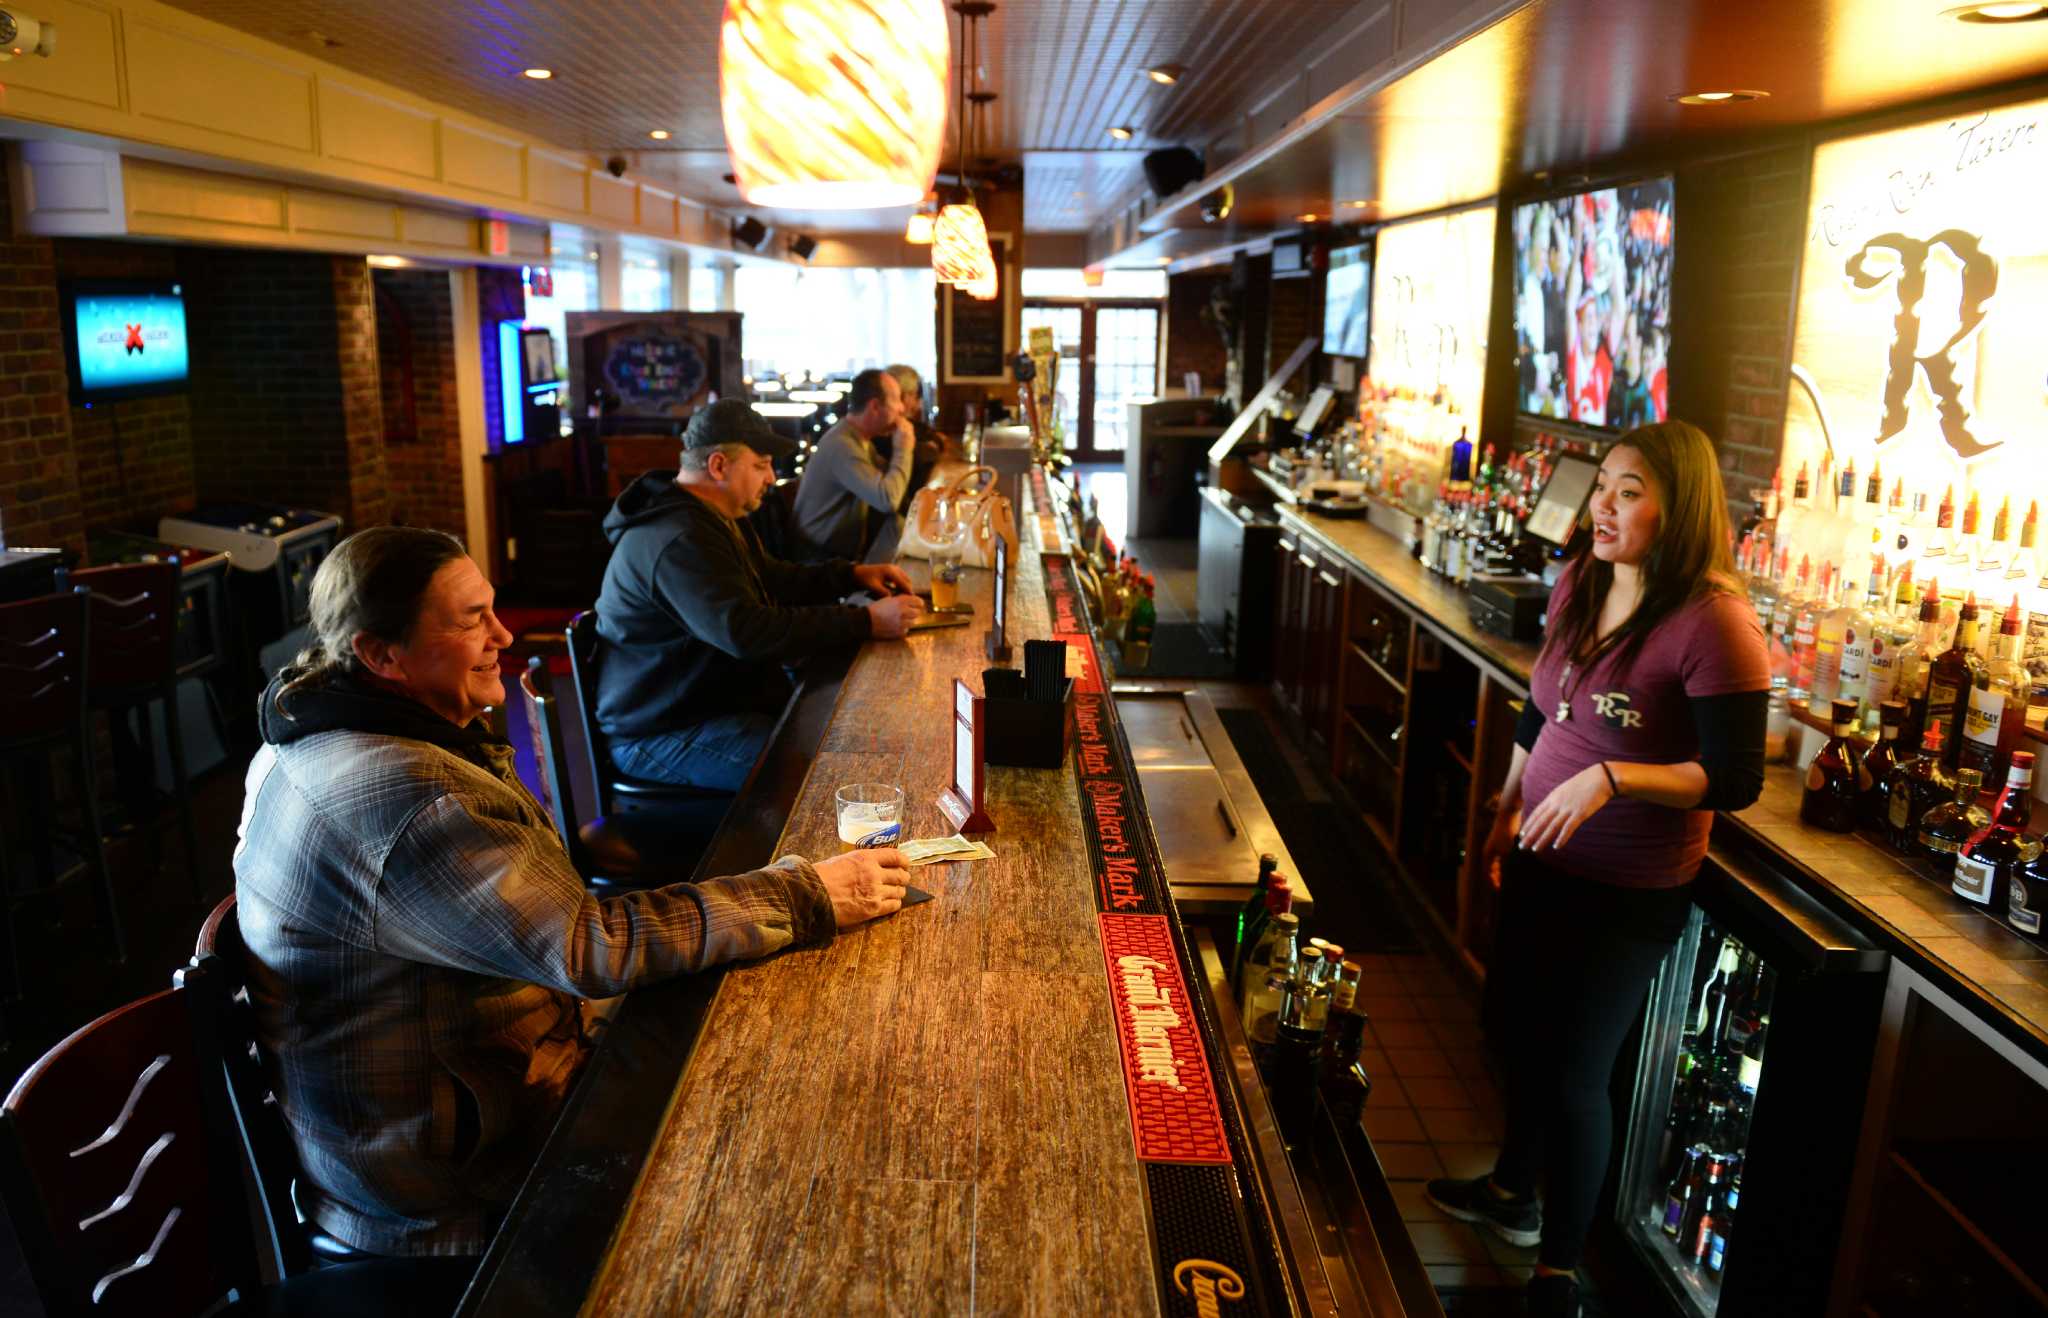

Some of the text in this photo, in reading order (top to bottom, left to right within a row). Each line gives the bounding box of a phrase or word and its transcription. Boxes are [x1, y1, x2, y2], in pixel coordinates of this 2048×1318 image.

[1081, 743, 1112, 774] Mark
[1093, 794, 1130, 852] Maker's
[1104, 856, 1145, 909] Mark
[1117, 955, 1185, 1090] Grand Marnier
